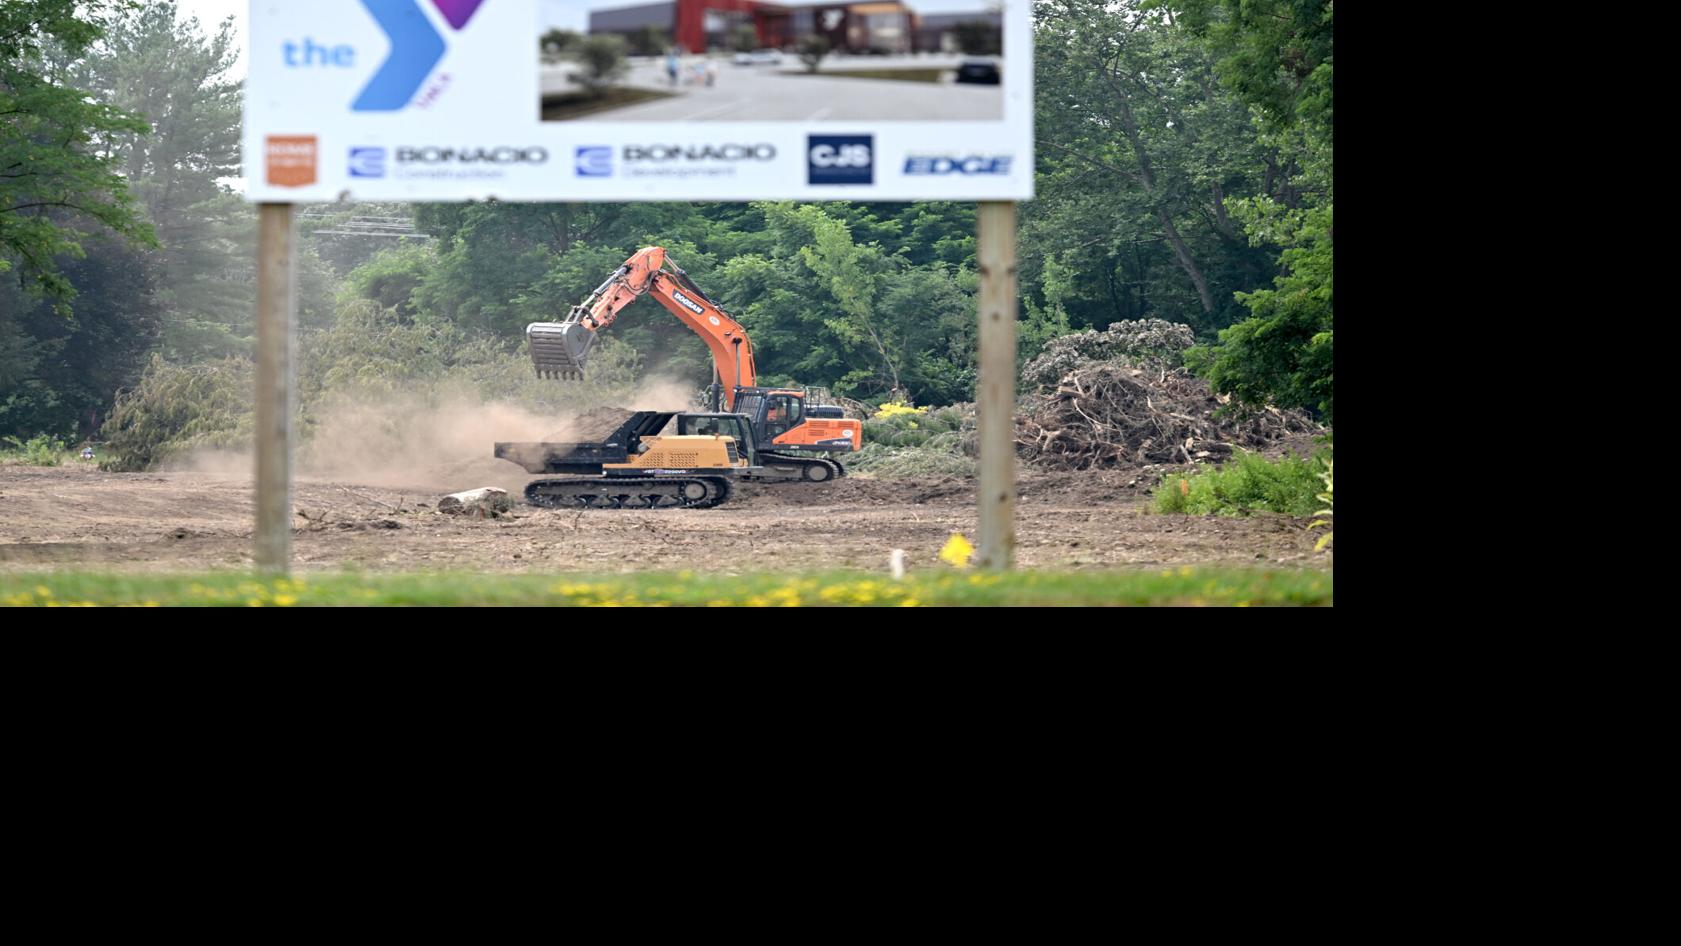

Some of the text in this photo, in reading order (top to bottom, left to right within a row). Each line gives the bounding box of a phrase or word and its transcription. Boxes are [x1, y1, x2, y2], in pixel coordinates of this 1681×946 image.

[282, 37, 355, 67] the
[396, 146, 549, 164] BONACIO
[622, 144, 776, 162] BONACIO
[810, 143, 871, 168] CJS
[903, 155, 1014, 174] EDGE
[673, 291, 703, 314] DOOSAN
